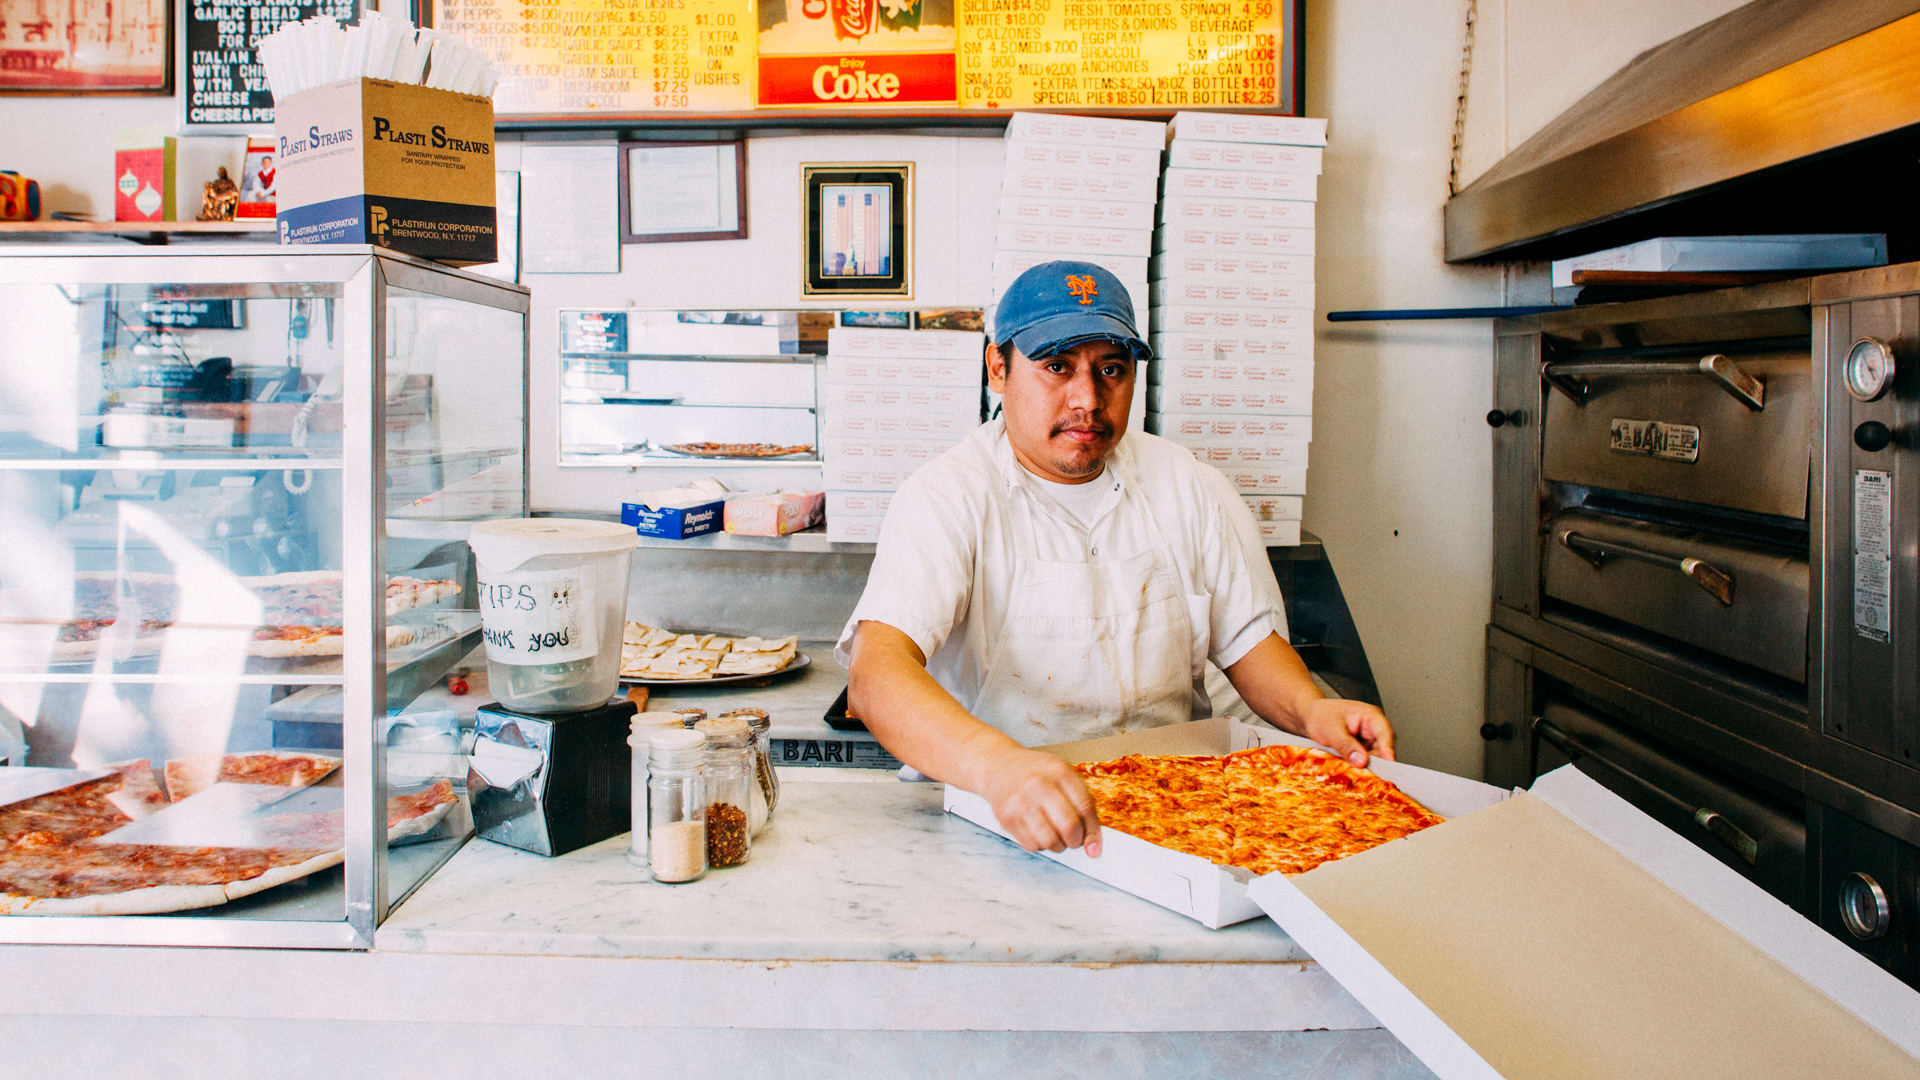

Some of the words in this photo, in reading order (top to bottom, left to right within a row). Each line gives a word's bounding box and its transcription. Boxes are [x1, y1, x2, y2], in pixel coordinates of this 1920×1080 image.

[645, 0, 686, 9] DISHES
[963, 0, 1010, 12] SICILIAN
[1064, 4, 1103, 16] FRESH
[1108, 4, 1172, 16] TOMATOES
[1180, 4, 1231, 16] SPINACH
[194, 7, 246, 20] GARLIC
[250, 7, 300, 20] BREAD
[464, 9, 502, 20] PEPPS
[696, 13, 736, 26] $1.00
[965, 14, 1000, 26] WHITE
[1064, 18, 1120, 31] PEPPERS
[1121, 18, 1130, 30] &
[1133, 17, 1178, 30] ONIONS
[1190, 20, 1255, 33] BEVERAGE
[617, 25, 651, 37] SAUCE
[700, 31, 739, 42] EXTRA
[976, 27, 1041, 40] CALZONES
[218, 34, 245, 48] FOR
[563, 39, 604, 50] GARLIC
[608, 39, 641, 50] SAUCE
[1081, 32, 1144, 45] EGGPLANT
[1217, 34, 1243, 46] CUP
[700, 46, 734, 57] PARM
[964, 42, 982, 54] SM
[1081, 46, 1141, 59] BROCCOLI
[193, 51, 249, 64] ITALIAN
[563, 53, 604, 65] GARLIC
[605, 53, 614, 65] &
[1217, 49, 1243, 61] CUP
[706, 60, 722, 71] ON
[840, 58, 865, 69] Enjoy
[966, 56, 981, 68] LG
[1081, 60, 1149, 73] ANCHOVIES
[192, 64, 230, 78] WITH
[563, 67, 596, 79] CLAM
[600, 67, 639, 79] SAUCE
[1018, 64, 1043, 76] MED
[1217, 63, 1242, 75] CAN
[193, 78, 232, 92] WITH
[694, 73, 740, 86] DISHES
[812, 65, 900, 101] Coke
[964, 73, 983, 85] SM
[1040, 78, 1077, 89] EXTRA
[1083, 78, 1119, 89] ITEMS
[1193, 77, 1241, 90] BOTTLE
[1242, 77, 1275, 90] $1.40
[563, 81, 630, 93] MUSHROOM
[965, 86, 981, 99] LG
[192, 91, 250, 105] CHEESE
[1033, 92, 1081, 104] SPECIAL
[1087, 92, 1106, 104] PIE
[1167, 91, 1188, 104] LTR
[1193, 91, 1241, 104] BOTTLE
[1241, 91, 1275, 104] $2.25
[406, 150, 433, 160] SANITARY
[434, 152, 461, 163] WRAPPED
[401, 157, 414, 165] FOR
[414, 159, 430, 167] YOUR
[431, 160, 466, 171] PROTECTION
[318, 217, 359, 232] CORPORATION
[392, 218, 436, 230] PLASTIRUN
[437, 222, 493, 235] CORPORATION
[392, 228, 441, 241] BRENTWOOD,
[457, 233, 476, 242] 11717
[684, 510, 715, 526] Reynolds
[478, 581, 537, 611] TIPS
[783, 740, 854, 763] BARI
